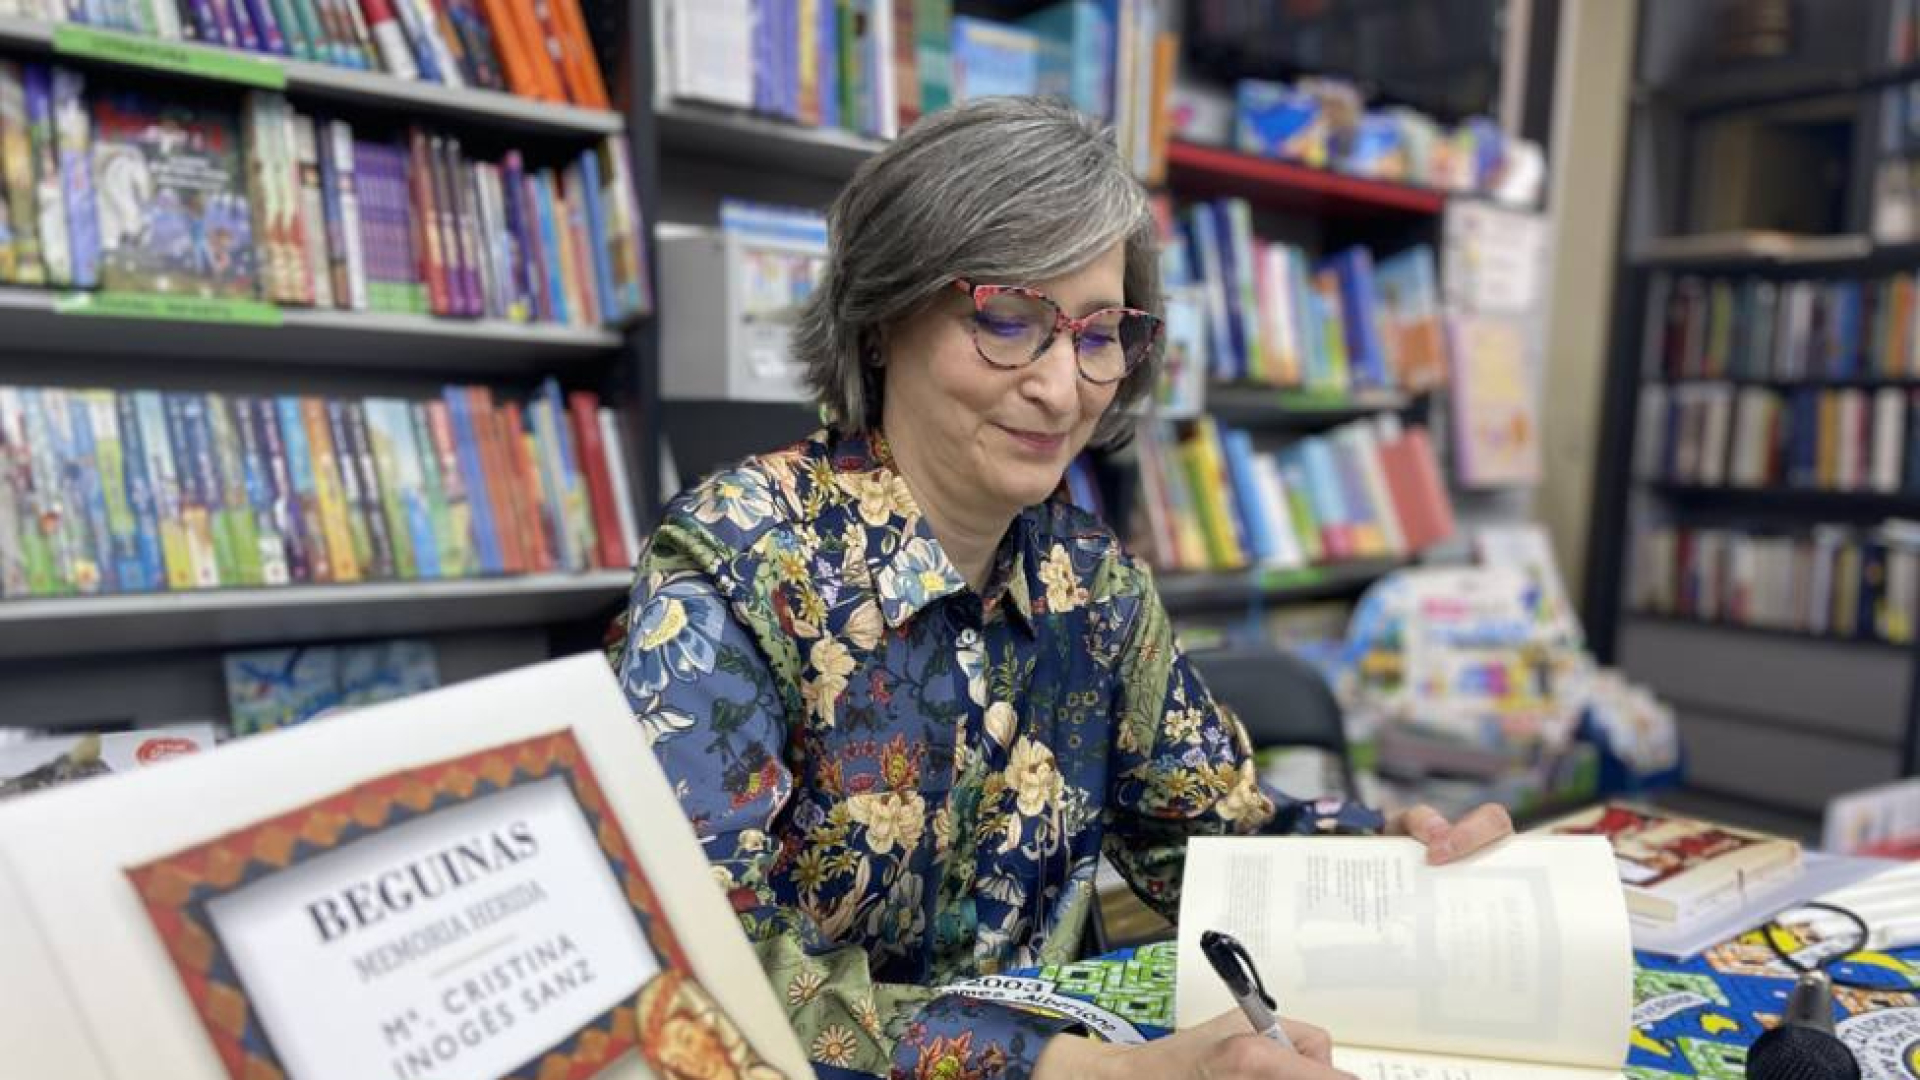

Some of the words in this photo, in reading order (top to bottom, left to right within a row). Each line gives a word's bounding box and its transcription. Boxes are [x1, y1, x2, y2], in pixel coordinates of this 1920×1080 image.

[306, 820, 539, 942] BEGUINAS
[353, 914, 471, 984] MEMORIA
[464, 879, 549, 930] HERIDA
[441, 932, 578, 1016] CRISTINA
[519, 957, 598, 1014] SANZ
